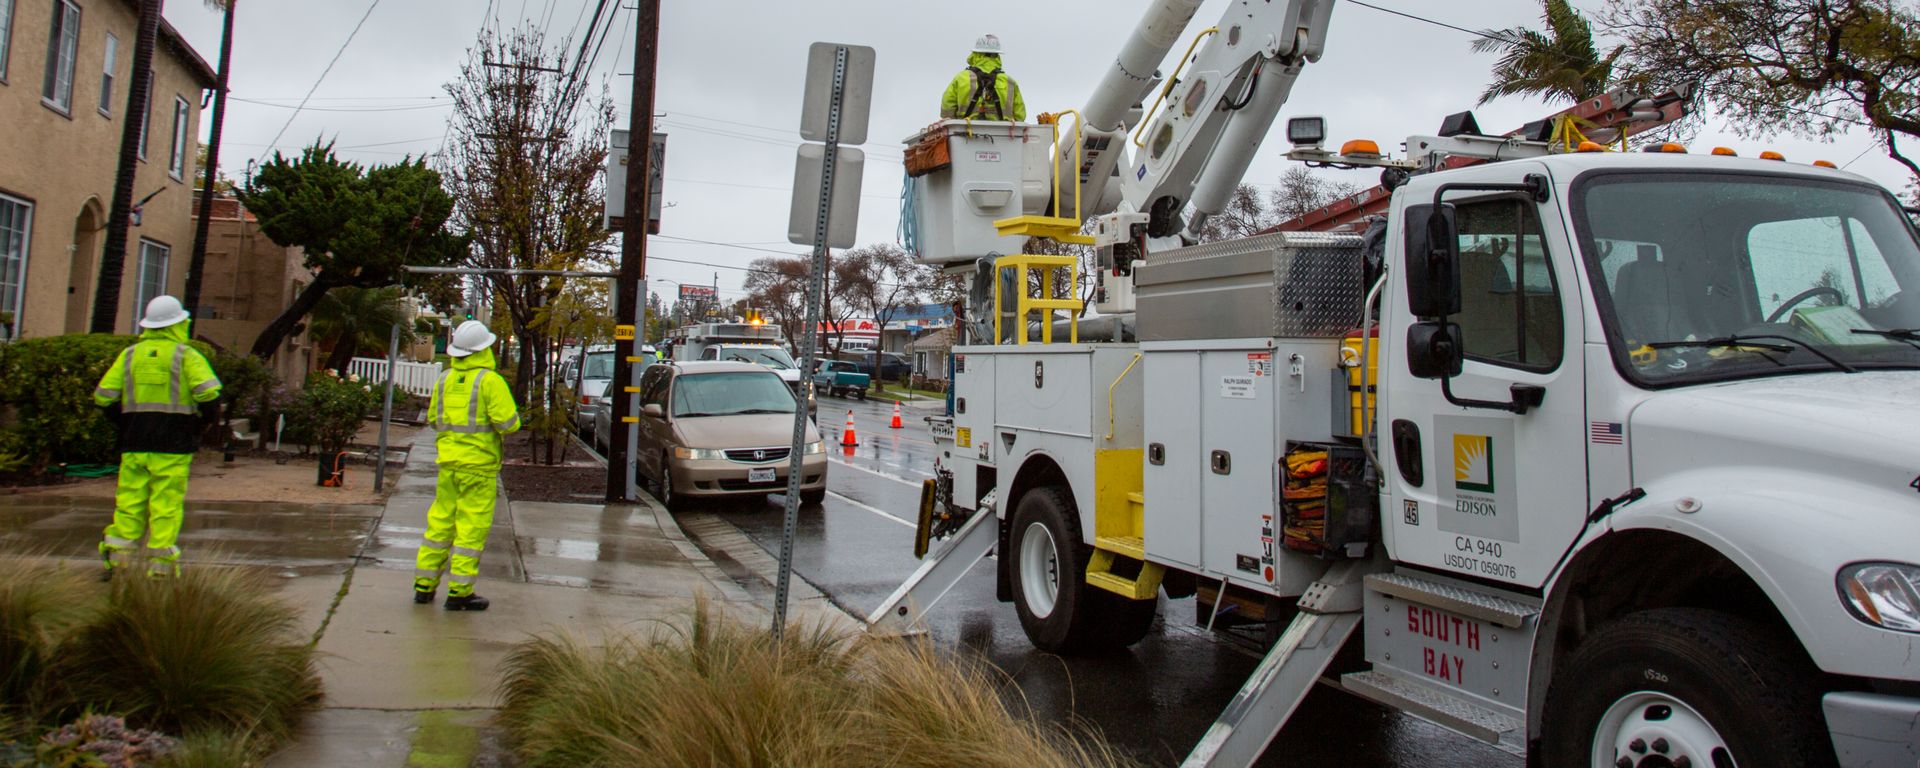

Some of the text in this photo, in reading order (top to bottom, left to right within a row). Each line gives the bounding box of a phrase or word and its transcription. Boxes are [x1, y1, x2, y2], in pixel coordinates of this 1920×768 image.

[1406, 505, 1417, 523] 45
[1456, 500, 1496, 517] EDISON
[1455, 536, 1502, 558] CA 940
[1444, 553, 1516, 579] USDOT 059076
[1407, 605, 1480, 651] SOUTH
[1424, 646, 1464, 685] BAY
